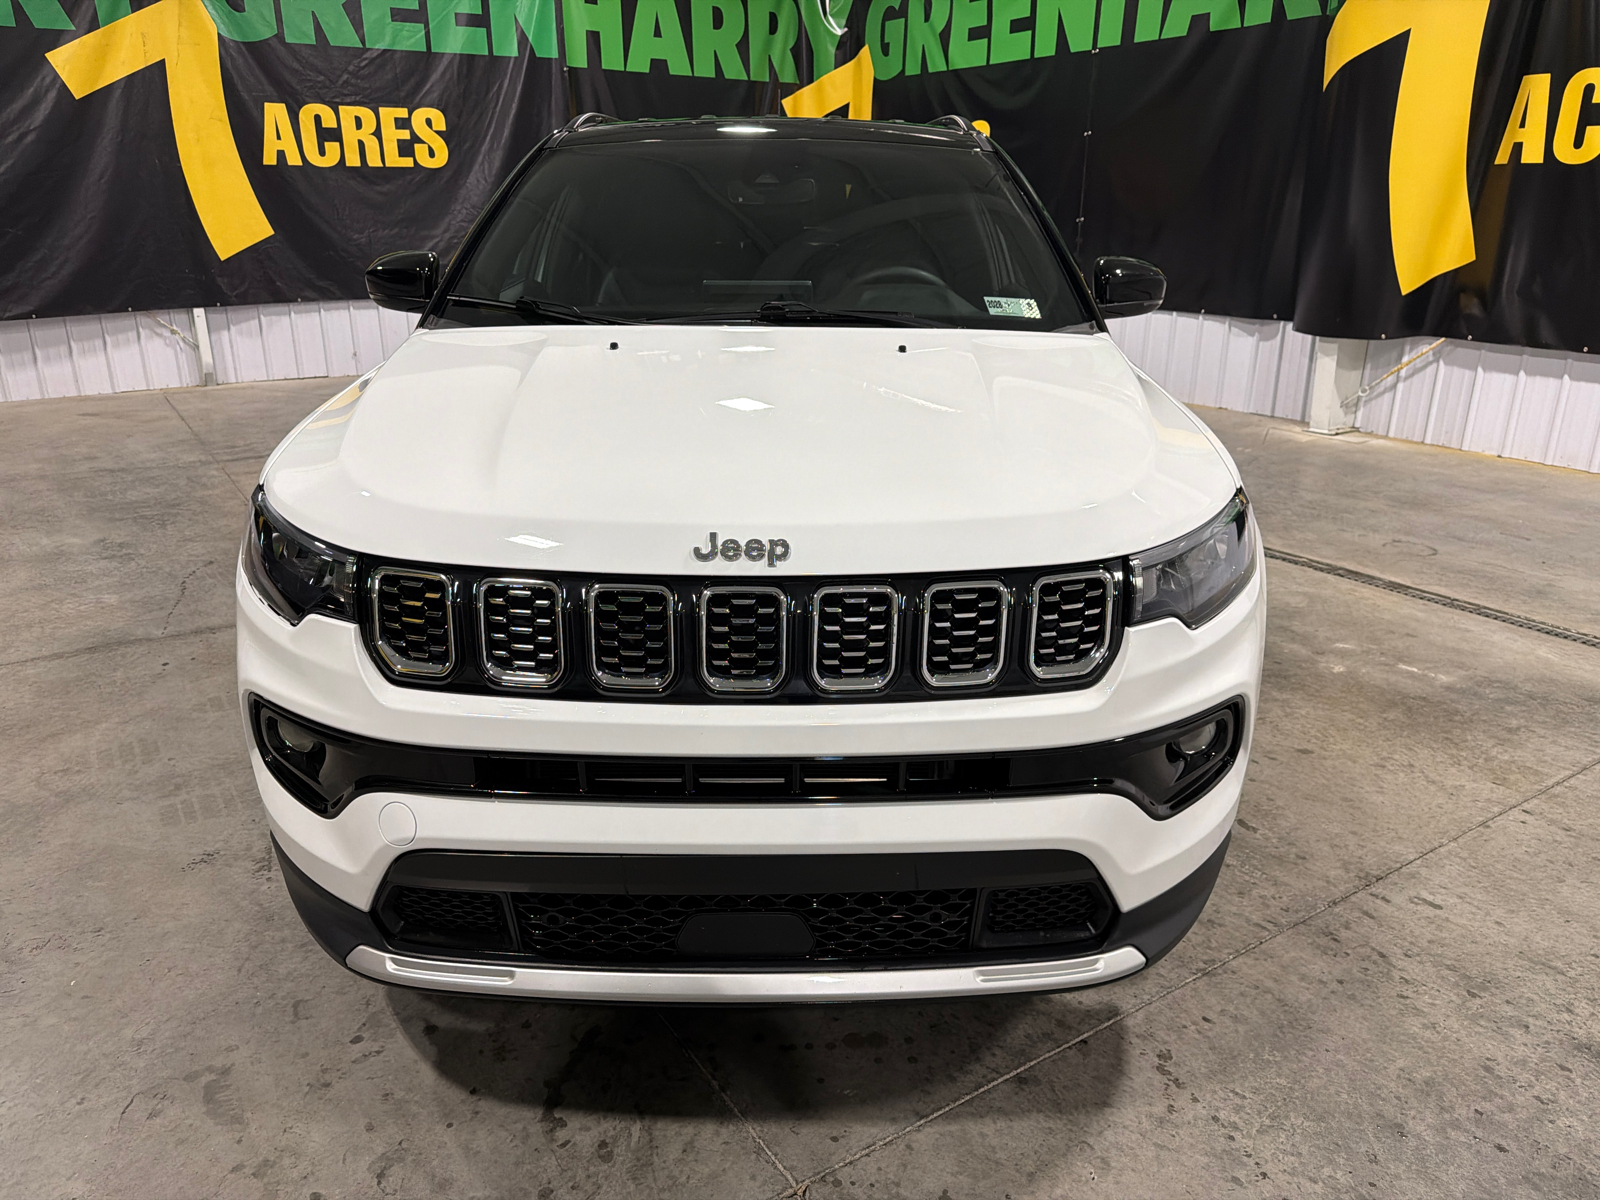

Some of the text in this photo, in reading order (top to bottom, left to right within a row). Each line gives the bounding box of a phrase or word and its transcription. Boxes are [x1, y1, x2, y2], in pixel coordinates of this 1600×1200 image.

[562, 0, 851, 84] HARRY
[262, 102, 449, 169] ACRES
[693, 532, 790, 568] Jeep
